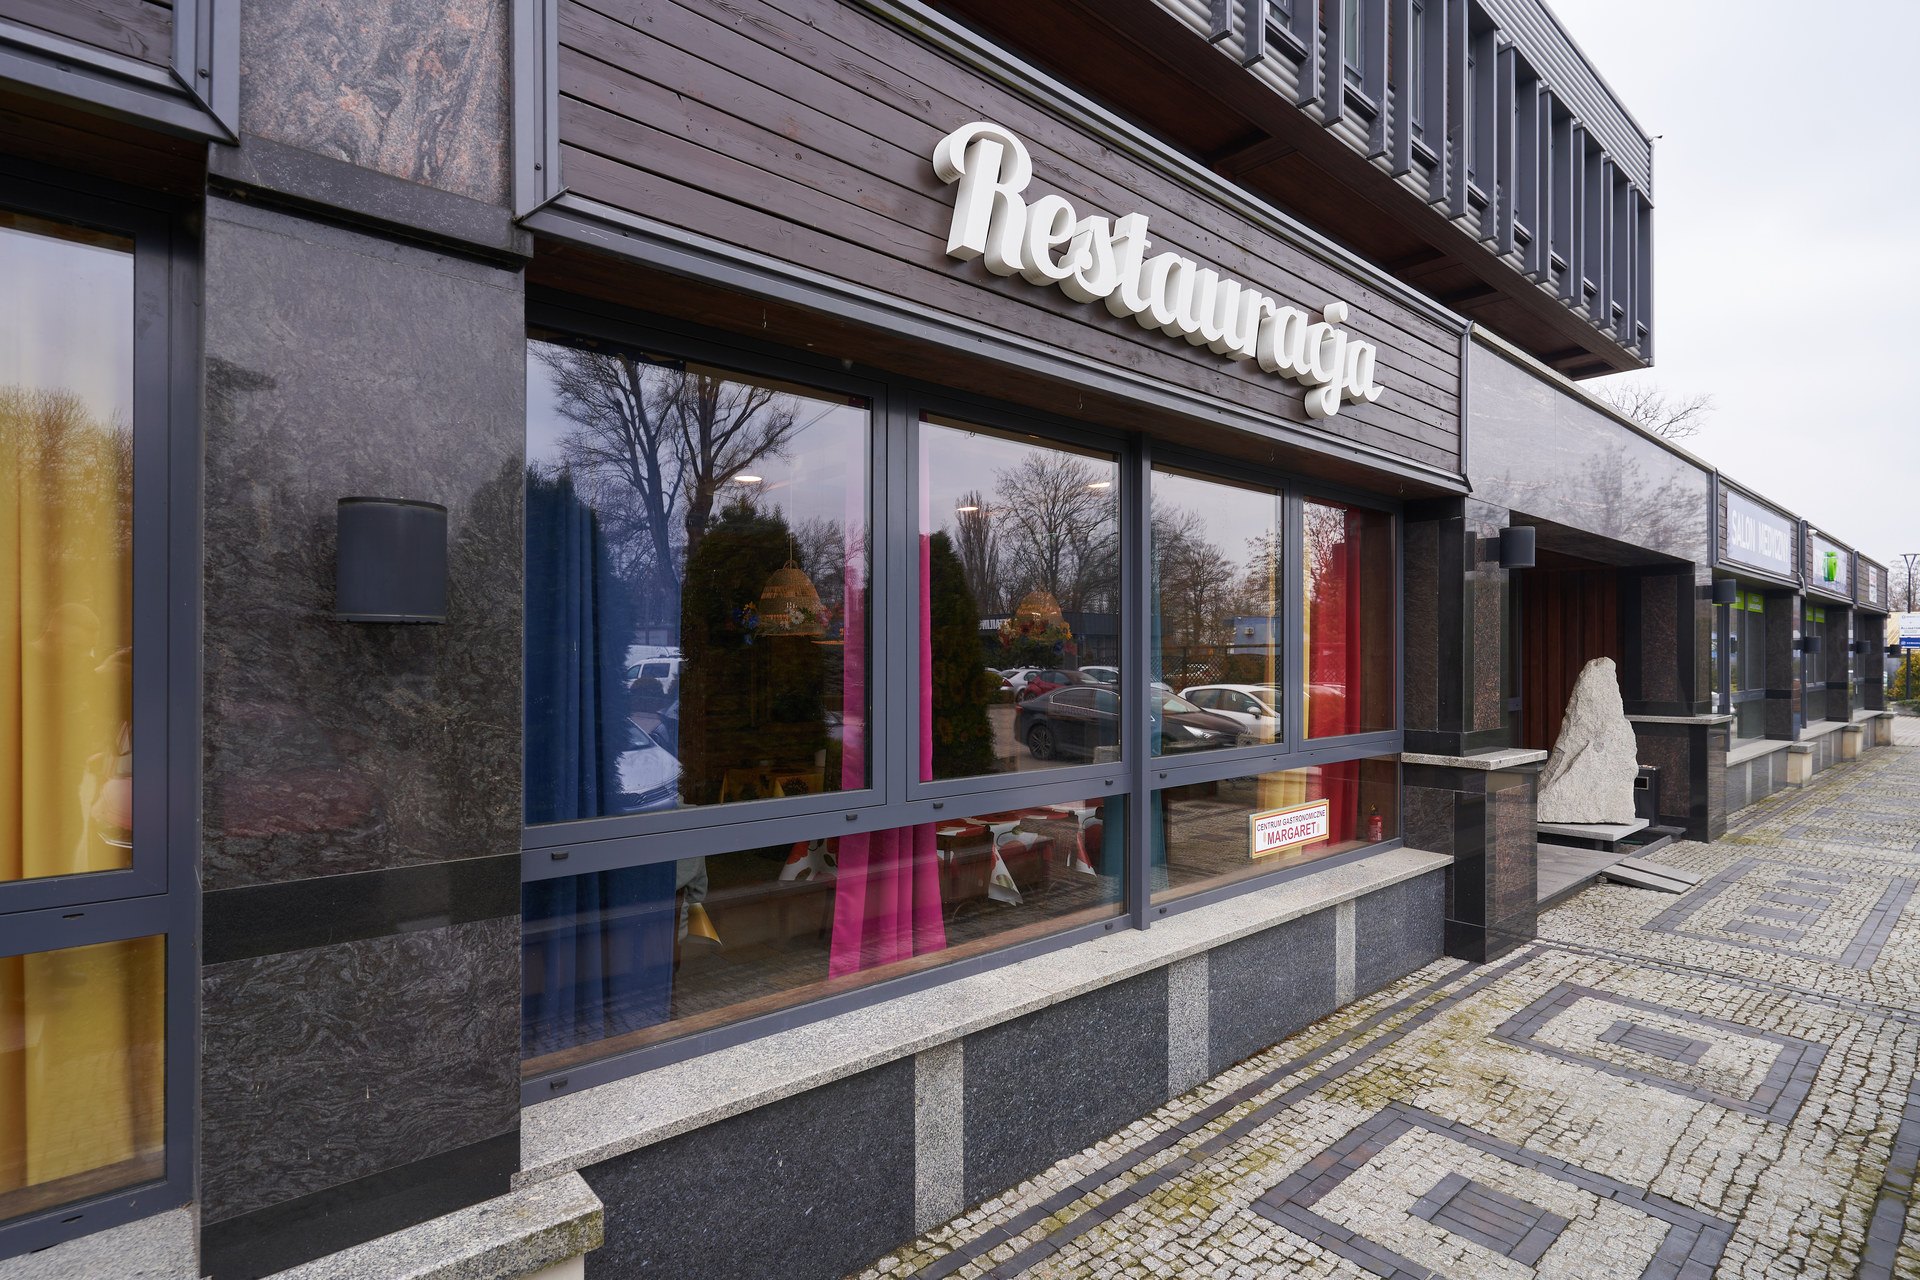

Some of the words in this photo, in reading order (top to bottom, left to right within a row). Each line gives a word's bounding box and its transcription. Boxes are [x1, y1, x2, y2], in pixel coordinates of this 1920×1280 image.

[932, 121, 1384, 419] Restauracja
[1732, 510, 1755, 552] SALON
[1257, 820, 1282, 831] CENTRUM
[1283, 810, 1325, 825] GASTRONOMICZNE
[1268, 822, 1316, 845] MARGARET
